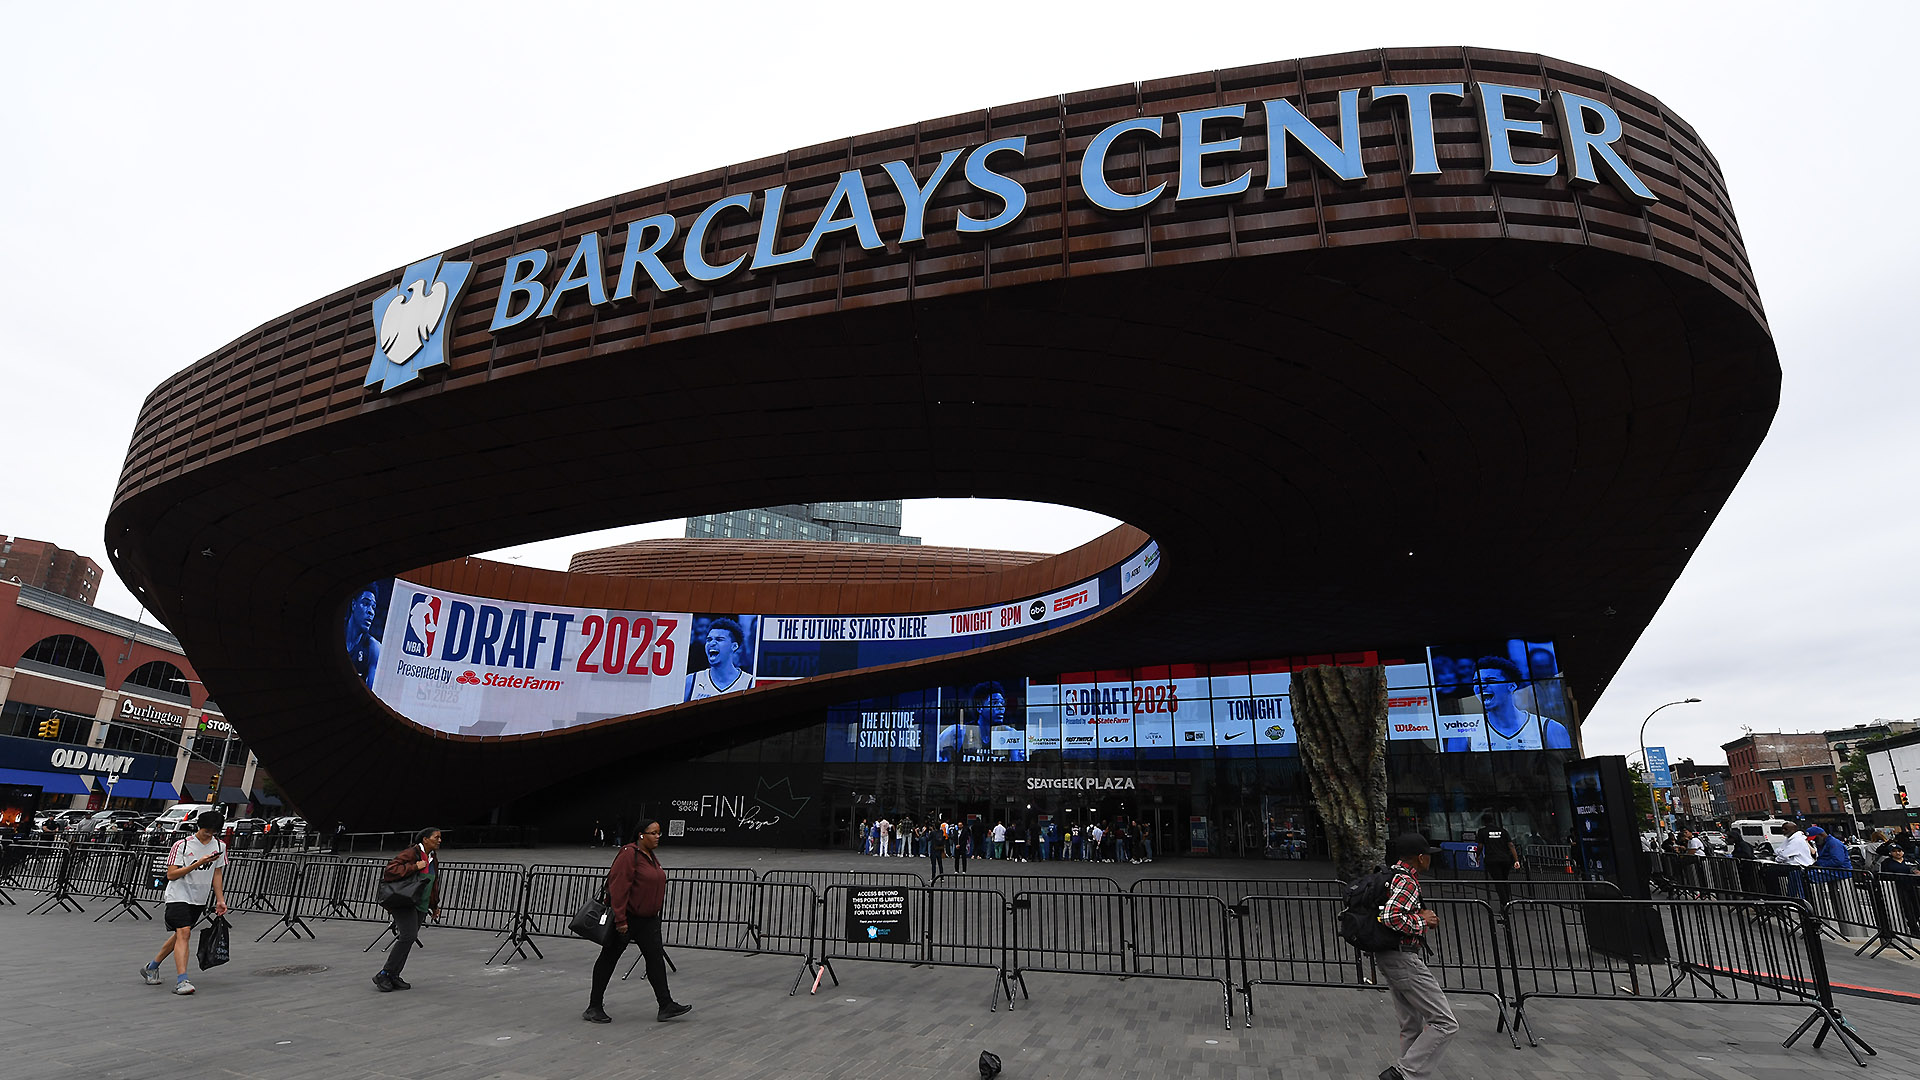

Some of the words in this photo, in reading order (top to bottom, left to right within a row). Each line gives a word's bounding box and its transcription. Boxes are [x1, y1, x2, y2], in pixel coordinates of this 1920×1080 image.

[487, 135, 1028, 333] BARCLAYS
[1080, 82, 1660, 212] CENTER
[1030, 606, 1044, 615] abc
[1054, 590, 1088, 612] ESPN
[778, 619, 800, 640] THE
[802, 618, 846, 640] FUTURE
[848, 618, 896, 639] STARTS
[898, 616, 928, 638] HERE
[950, 610, 992, 634] TONIGHT
[1000, 605, 1022, 627] 8PM
[404, 640, 422, 654] NBA
[441, 600, 575, 671] DRAFT
[576, 614, 678, 677] 2023
[396, 660, 441, 680] Presented
[441, 666, 452, 684] by
[122, 699, 182, 724] Burlington
[1080, 688, 1129, 716] DRAFT
[1134, 685, 1178, 714] 2023
[1227, 698, 1283, 721] TONIGHT
[1388, 696, 1428, 708] ESPN
[862, 712, 878, 728] THE
[880, 712, 914, 728] FUTURE
[1394, 724, 1430, 732] Wilson
[1444, 720, 1480, 732] yahoo!
[860, 730, 896, 748] STARTS
[898, 730, 921, 748] HERE
[51, 748, 88, 768] OLD
[88, 752, 134, 774] NAVY
[1027, 777, 1084, 790] SEATGEEK
[1086, 778, 1135, 790] PLAZA
[700, 795, 744, 818] FINI
[738, 805, 780, 830] Pizza
[1577, 806, 1598, 814] WELCOME
